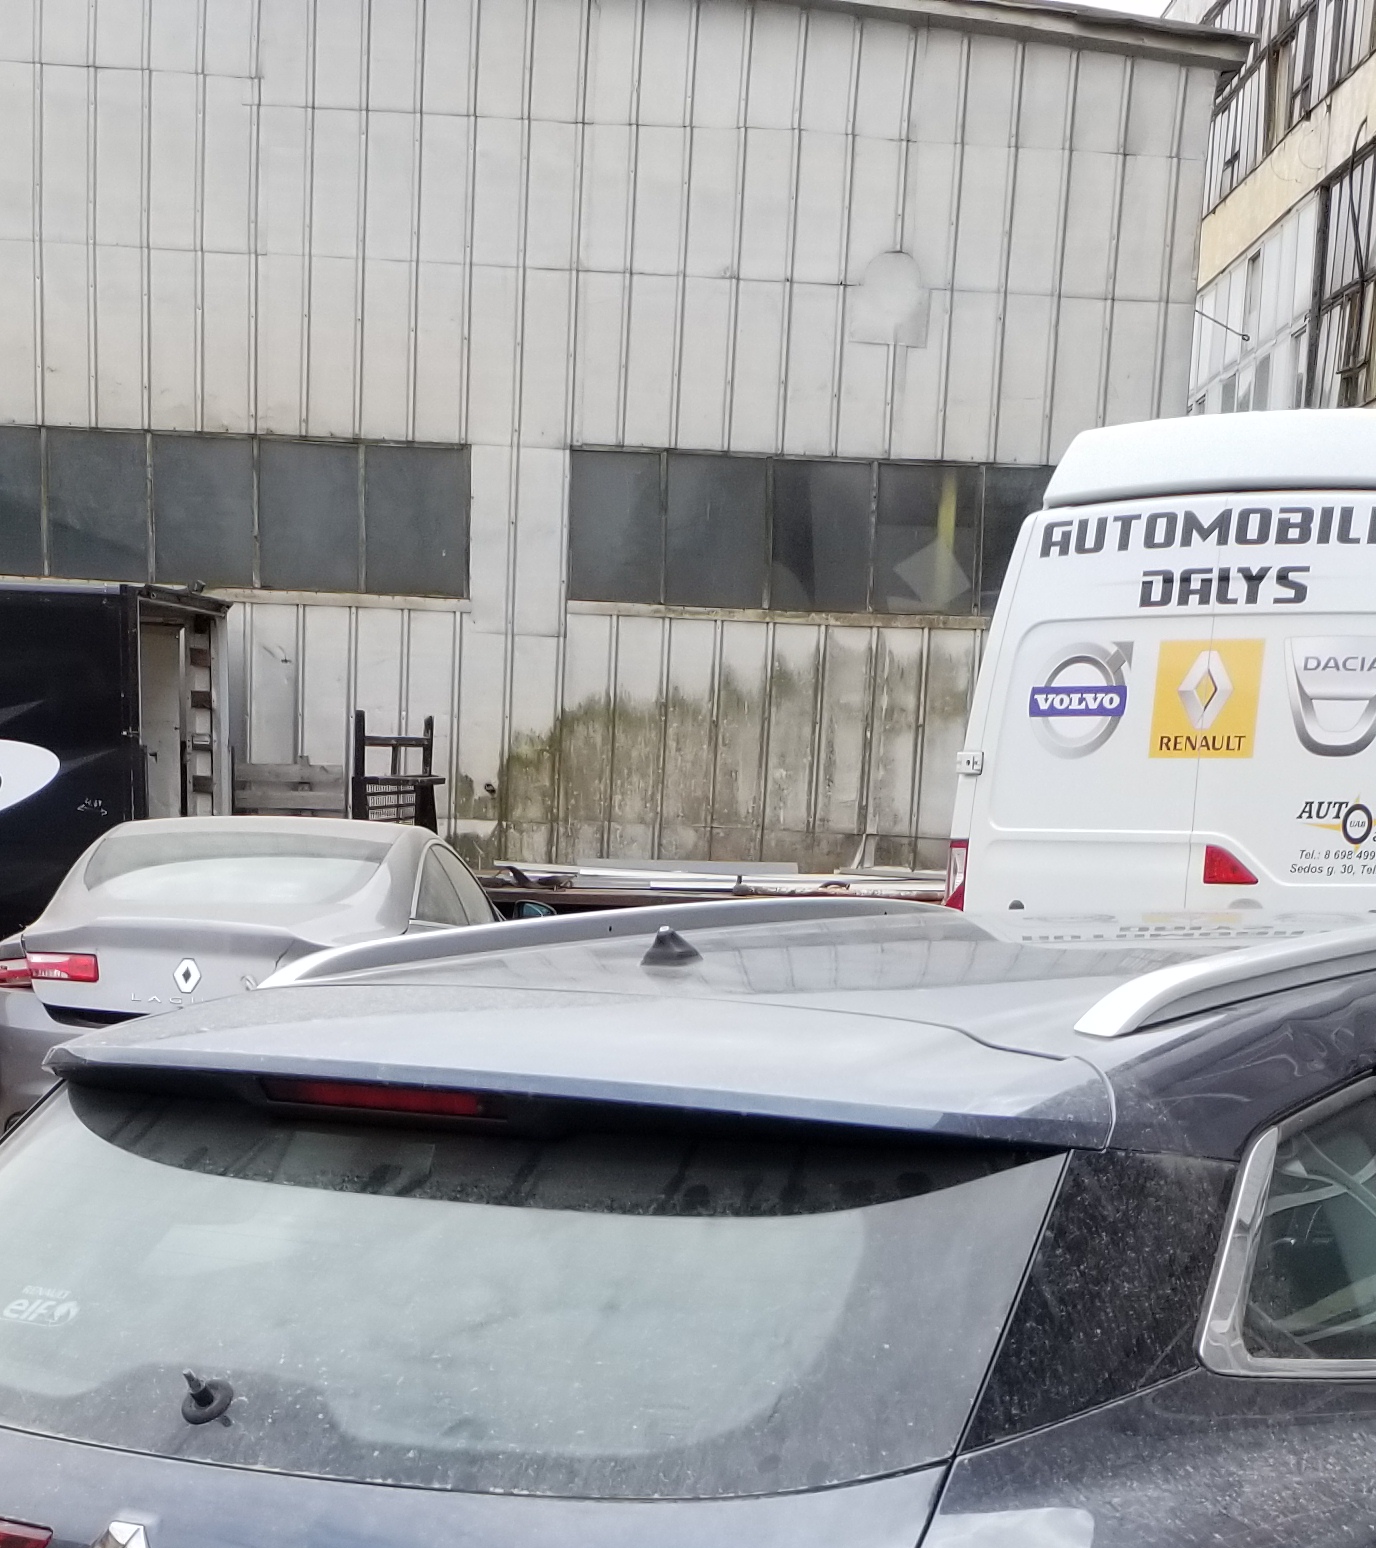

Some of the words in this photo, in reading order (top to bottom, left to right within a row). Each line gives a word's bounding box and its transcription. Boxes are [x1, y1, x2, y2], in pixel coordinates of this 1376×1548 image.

[1139, 566, 1311, 608] DALYS
[1033, 692, 1121, 711] VOLVO
[1159, 735, 1247, 752] RENAULT
[1324, 850, 1331, 860] 8
[1334, 850, 1353, 860] 698
[1289, 863, 1323, 874] Sedos
